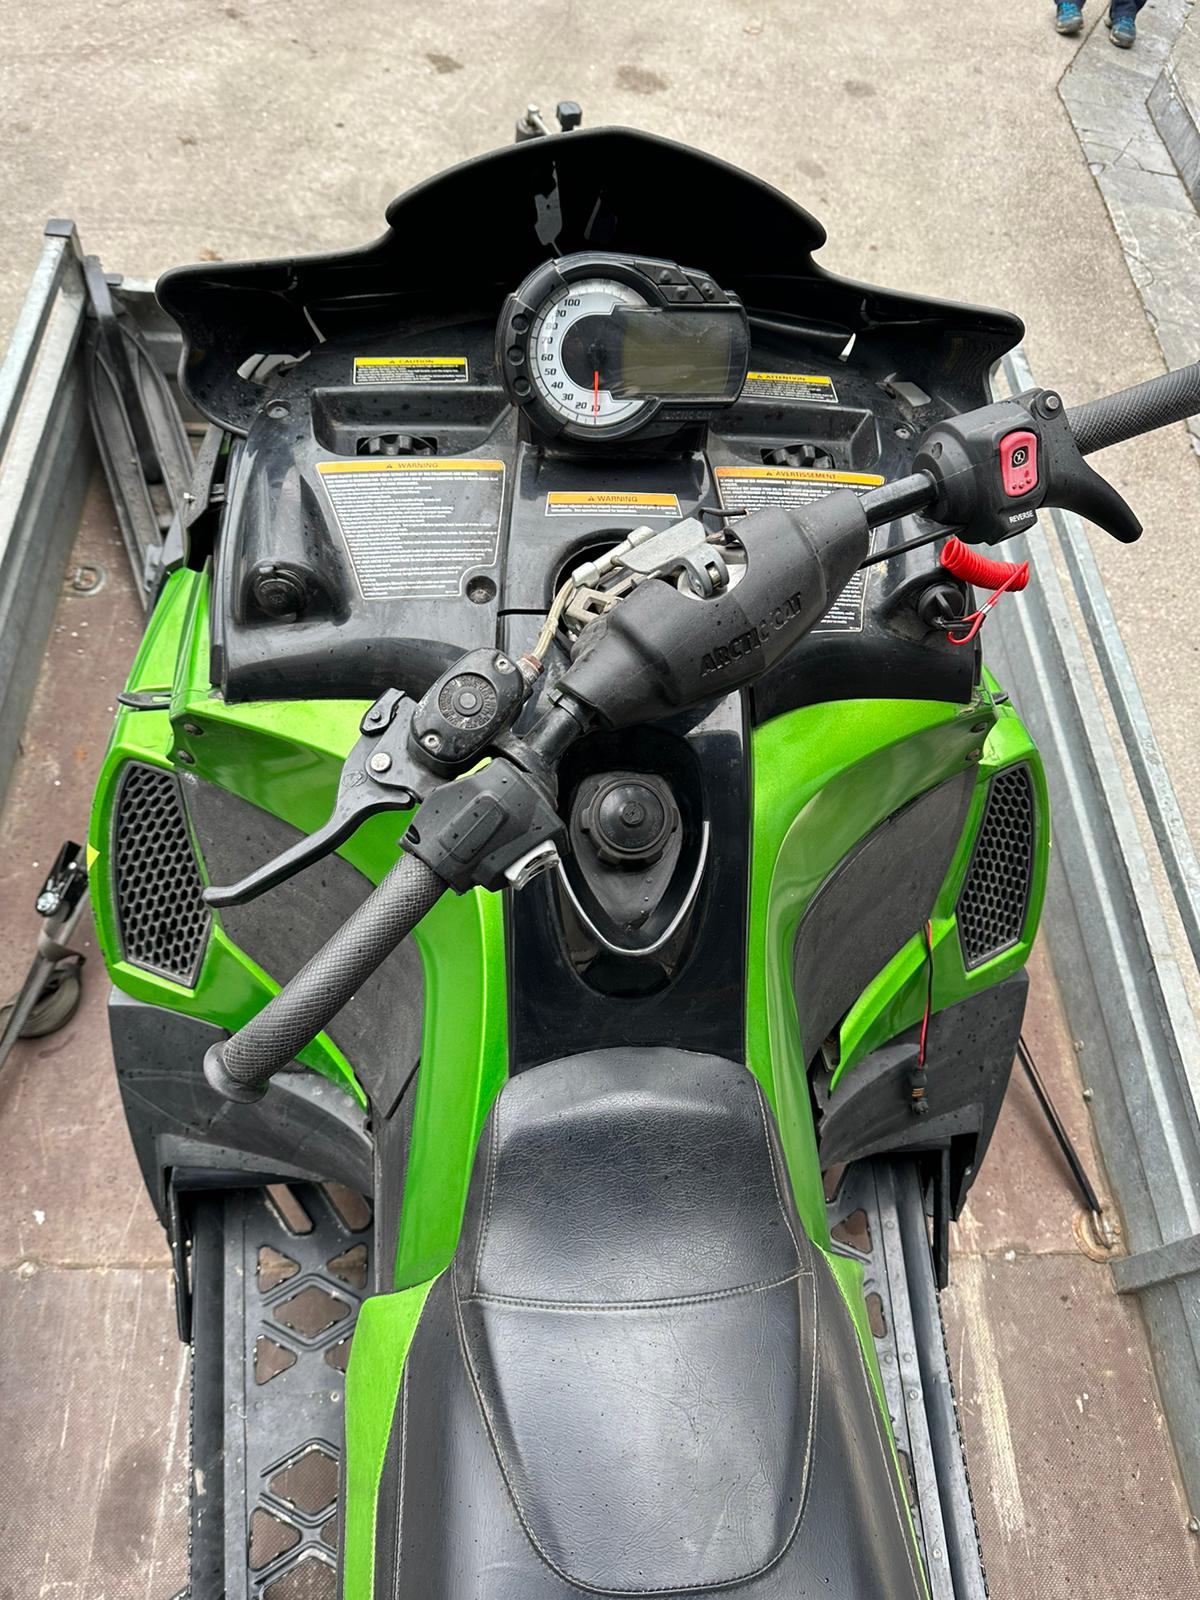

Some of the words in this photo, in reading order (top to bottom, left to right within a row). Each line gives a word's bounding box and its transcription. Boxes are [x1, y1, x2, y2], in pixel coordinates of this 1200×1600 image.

[776, 471, 836, 480] AVERTISSEMENT
[1009, 510, 1034, 523] REVERSE
[701, 620, 769, 677] ARCTIC
[772, 591, 802, 630] CAT
